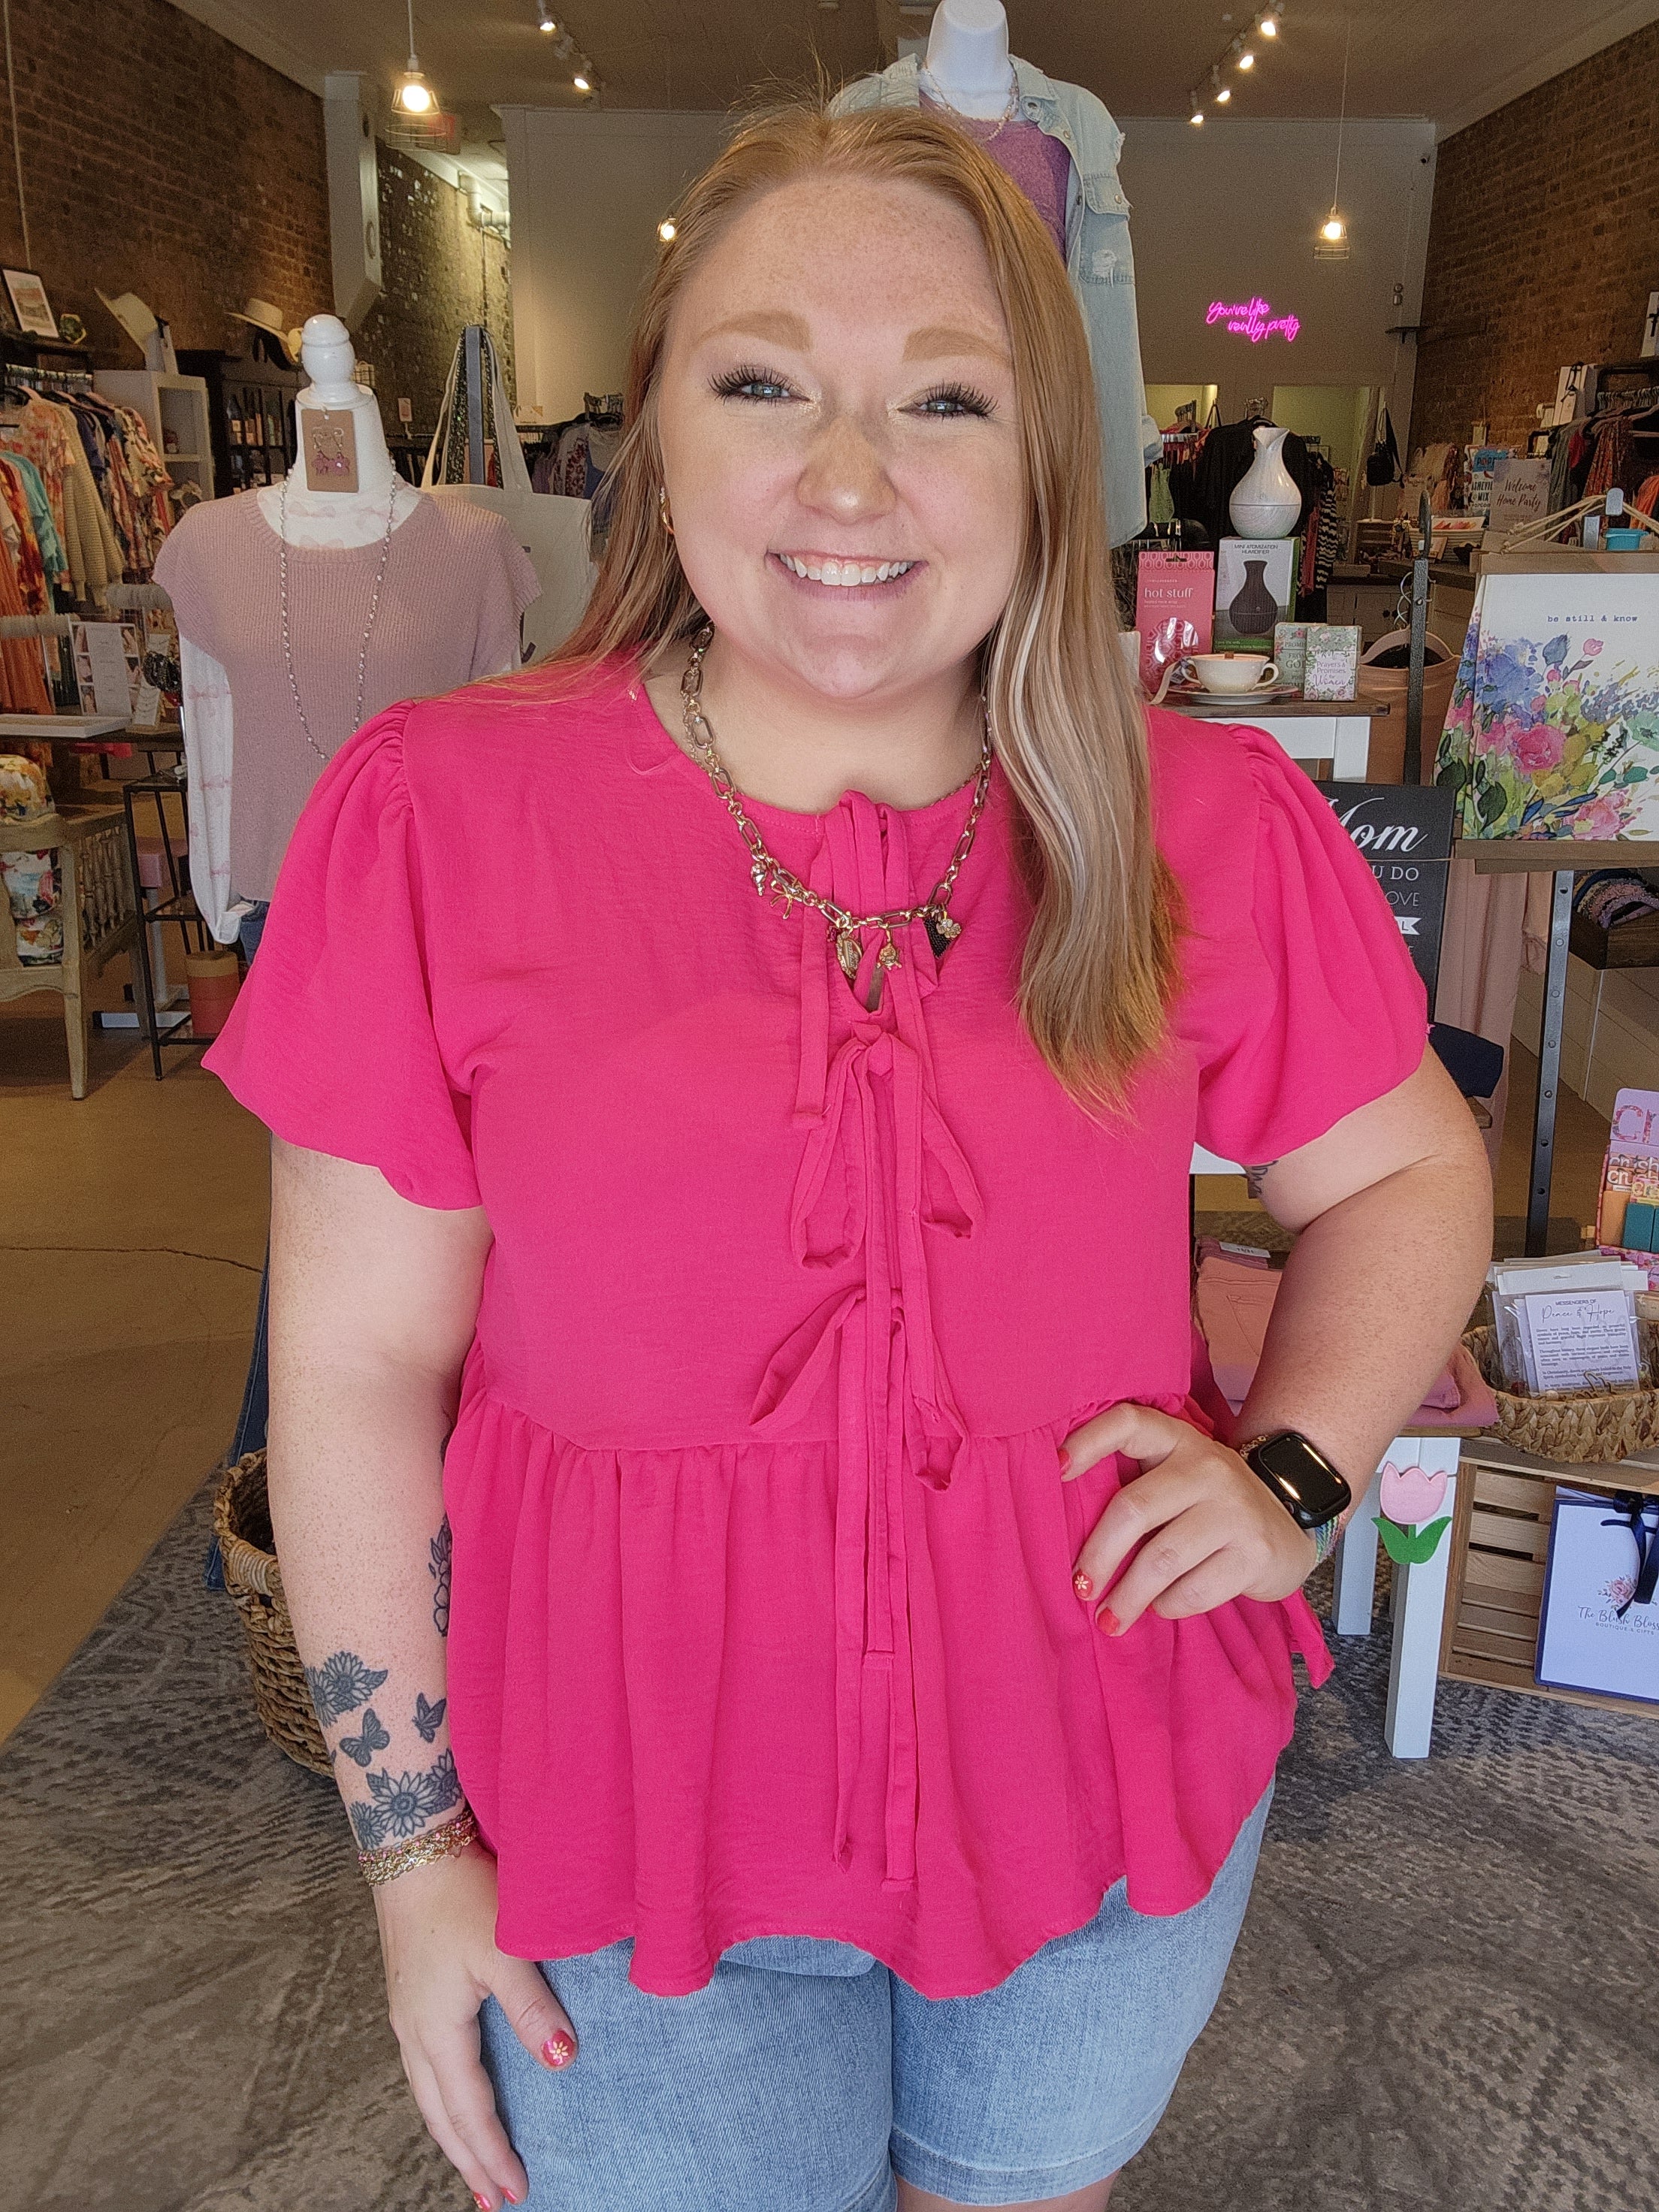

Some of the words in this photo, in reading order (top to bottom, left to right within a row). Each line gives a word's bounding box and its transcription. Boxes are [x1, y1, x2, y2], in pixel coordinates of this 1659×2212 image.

[1264, 314, 1301, 342] pretty
[1505, 478, 1537, 493] Welcome
[1497, 494, 1515, 506] Home
[1518, 494, 1541, 512] Party
[1144, 588, 1164, 598] hot
[1166, 588, 1194, 598] stuff
[1390, 866, 1419, 881] DO
[1542, 1305, 1573, 1323] Peace
[1584, 1304, 1615, 1322] Hope
[1578, 1606, 1594, 1619] The
[1599, 1609, 1630, 1624] Blush
[1595, 1622, 1627, 1631] BOUTIQUE
